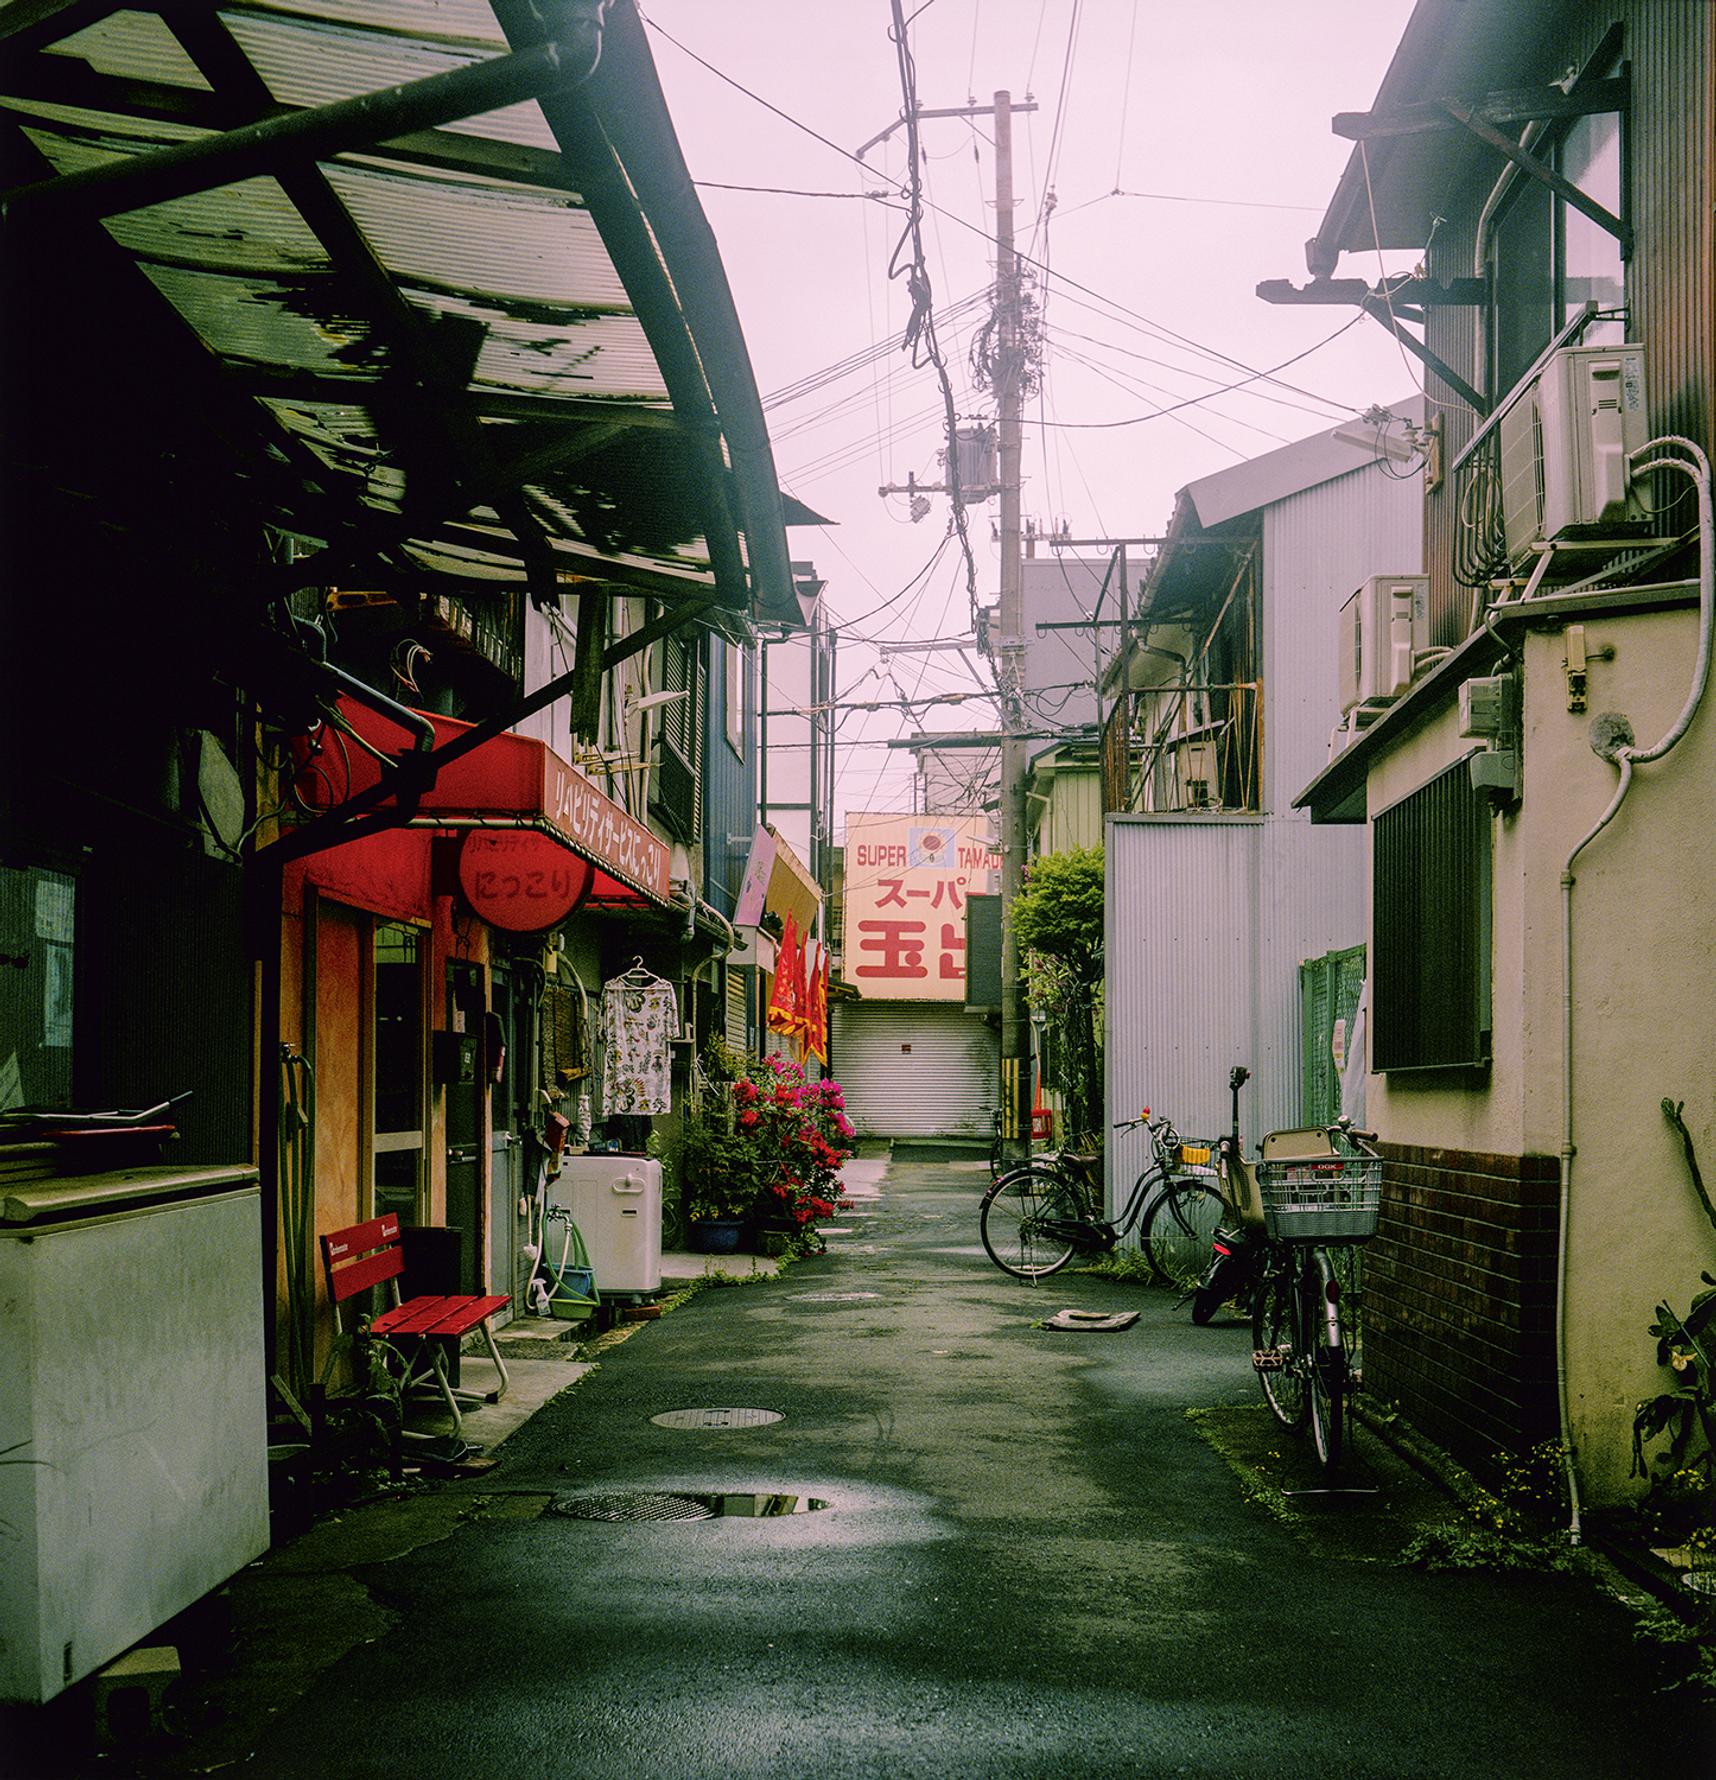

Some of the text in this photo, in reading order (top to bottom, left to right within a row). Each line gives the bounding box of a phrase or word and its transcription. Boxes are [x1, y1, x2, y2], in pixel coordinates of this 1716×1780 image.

[857, 844, 907, 867] SUPER
[475, 870, 571, 901] にっこり
[874, 876, 987, 909] スーパ
